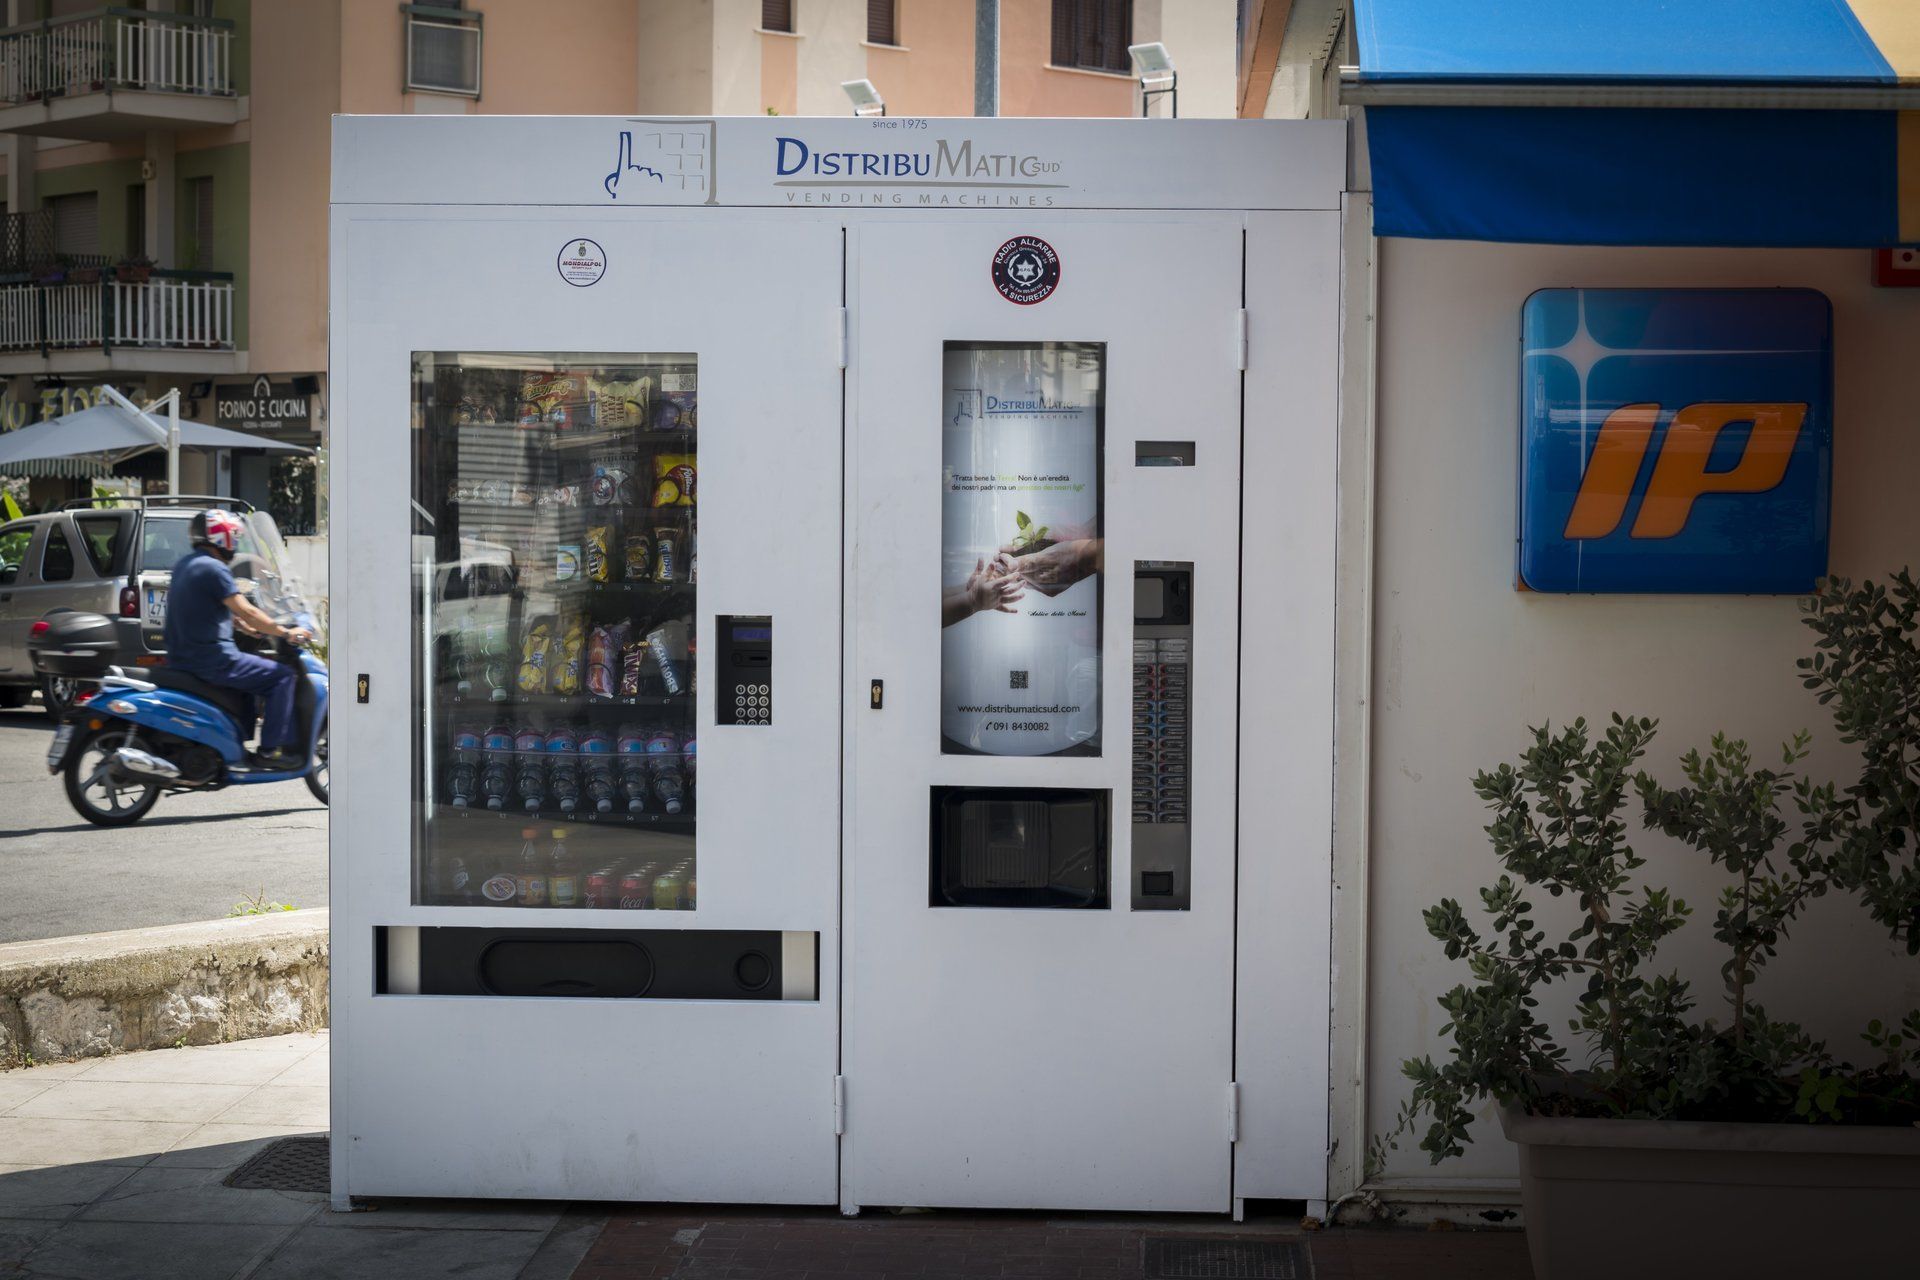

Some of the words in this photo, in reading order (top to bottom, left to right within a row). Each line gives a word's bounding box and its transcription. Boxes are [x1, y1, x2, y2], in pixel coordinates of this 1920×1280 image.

[872, 120, 898, 129] since
[902, 119, 928, 130] 1975
[786, 192, 902, 204] VENDING
[918, 193, 1054, 206] MACHINES
[995, 240, 1017, 264] RADIO
[1020, 238, 1056, 264] ALLARME
[998, 283, 1009, 295] LA
[1009, 285, 1052, 302] SICUREZZA
[218, 400, 256, 418] FORNO
[260, 400, 266, 418] E
[268, 399, 307, 418] CUCINA
[1563, 401, 1808, 540] IP
[980, 484, 996, 492] padri
[958, 704, 1080, 714] www.distribumaticsud.com
[994, 722, 1008, 731] 091
[1012, 722, 1049, 731] 8430082
